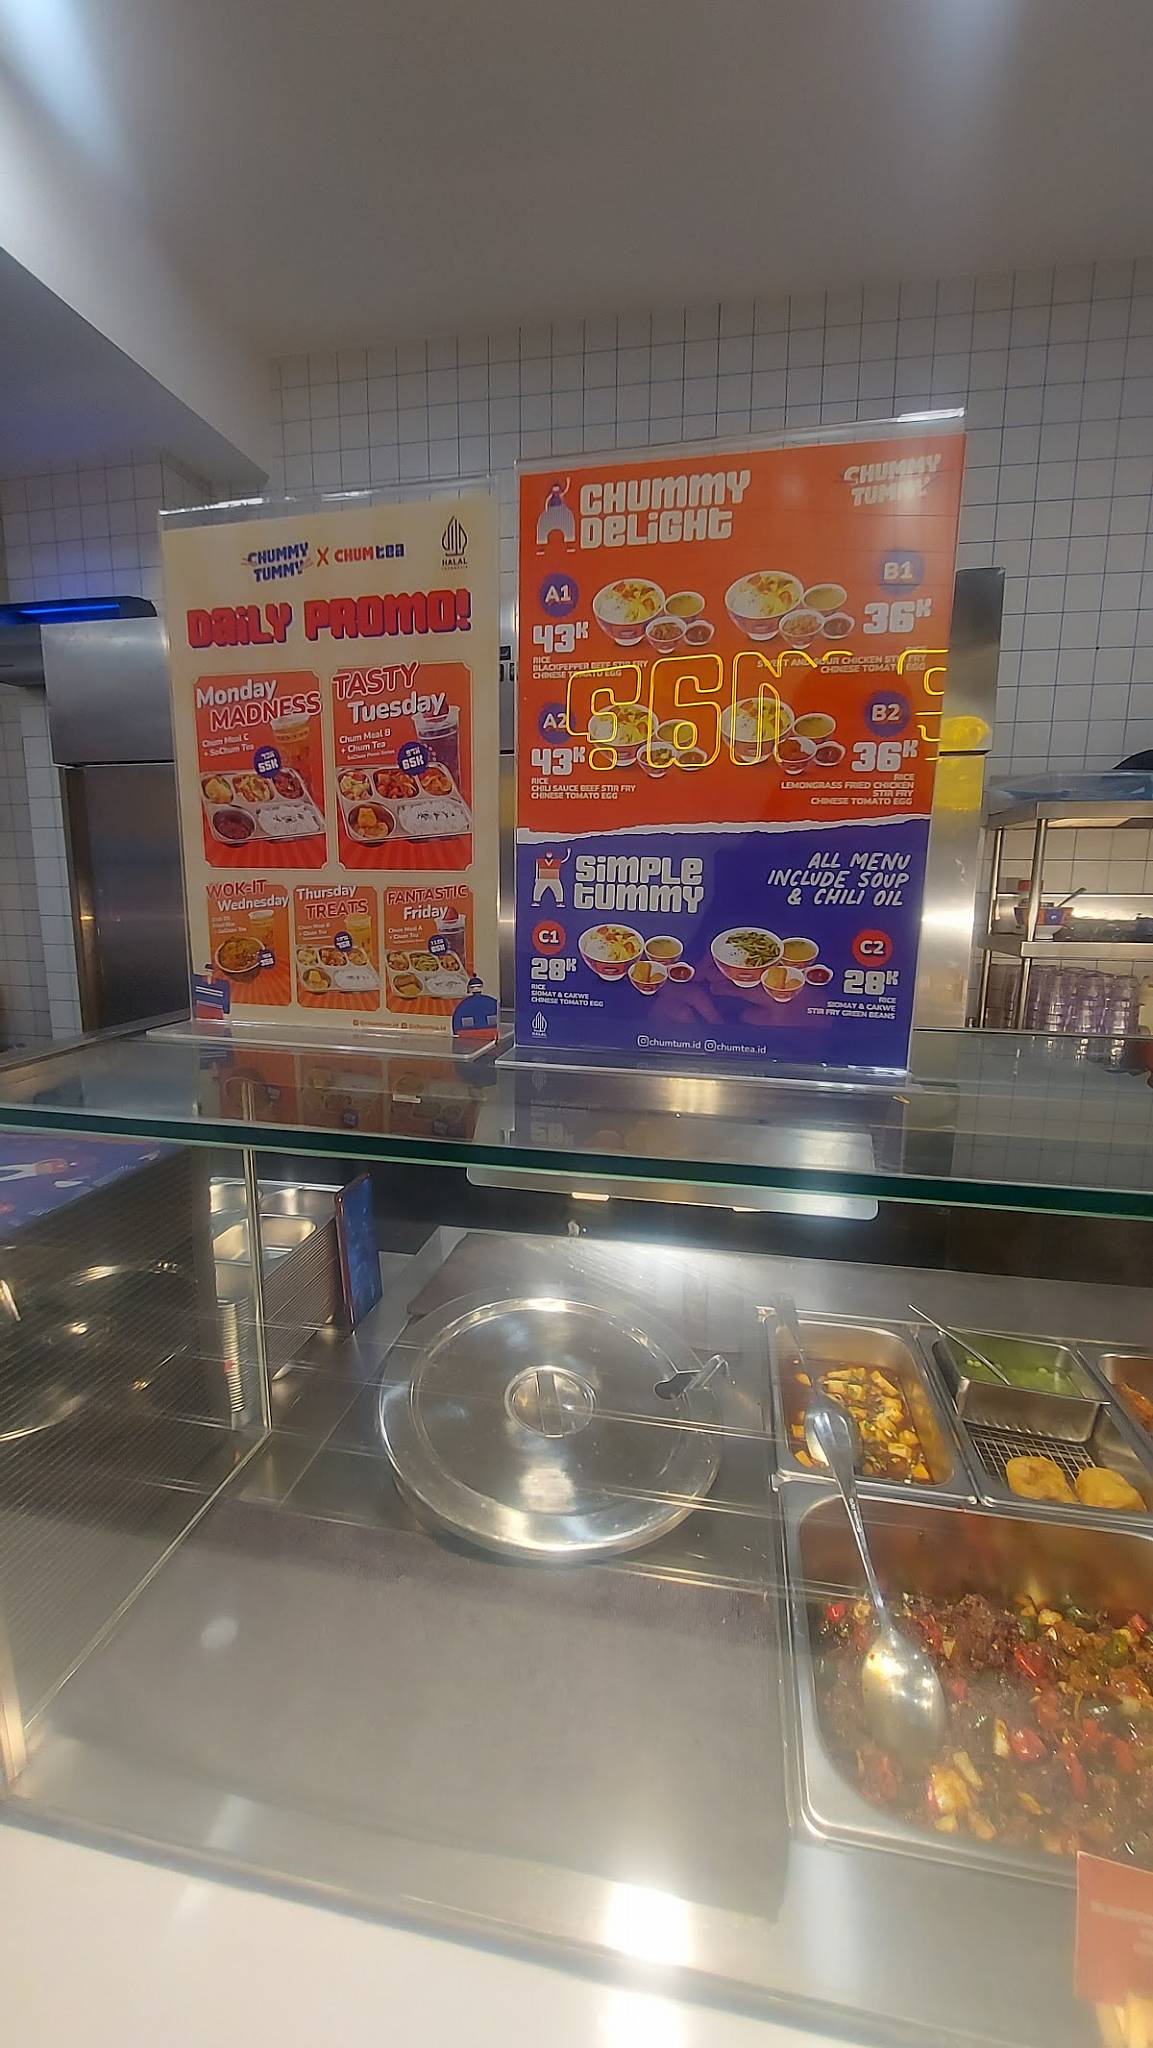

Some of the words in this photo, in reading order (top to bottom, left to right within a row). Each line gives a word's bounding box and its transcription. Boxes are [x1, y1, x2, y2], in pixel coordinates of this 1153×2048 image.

[844, 453, 941, 484] CHUMMY
[580, 470, 750, 516] CHUMMY
[247, 542, 309, 566] CHUMMY
[442, 557, 467, 566] HALAL
[254, 560, 304, 582] TUMMY
[884, 561, 912, 580] B1
[545, 584, 571, 603] A1
[863, 598, 932, 634] 36K
[533, 621, 588, 654] 43K
[533, 656, 551, 664] RICE
[533, 662, 589, 672] BLACKPEPPER
[842, 655, 882, 665] CHICKEN
[908, 654, 927, 662] FRY
[533, 671, 566, 680] CHINESE
[605, 669, 622, 677] EGG
[821, 664, 860, 674] CHINESE
[906, 662, 926, 671] EGG
[332, 660, 420, 700] TASTY
[197, 679, 276, 708] Monday
[210, 691, 321, 732] MADNESS
[347, 691, 445, 723] Tuesday
[872, 704, 900, 722] B2
[543, 713, 567, 729] A2
[340, 735, 361, 744] Chum
[364, 729, 382, 740] Meal
[348, 743, 370, 753] Chum
[372, 741, 386, 749] Tea
[402, 754, 425, 770] 65K
[531, 747, 585, 776] 43K
[851, 740, 918, 772] 36K
[258, 758, 279, 772] 55K
[894, 773, 915, 781] RICE
[531, 784, 551, 792] CHILI
[552, 784, 579, 792] SAUCE
[781, 781, 843, 790] LEMONGRASS
[844, 781, 871, 789] FRIED
[873, 781, 914, 789] CHICKEN
[873, 789, 894, 797] STIR
[895, 789, 914, 797] FRY
[531, 792, 564, 800] CHINESE
[566, 792, 600, 800] TOMATO
[601, 792, 618, 800] EGG
[810, 797, 849, 805] CHINESE
[851, 797, 892, 805] TOMATO
[893, 797, 913, 805] EGG
[808, 852, 841, 869] ALL
[850, 852, 912, 871] MENU
[767, 868, 850, 889] INCLUDE
[857, 871, 911, 889] SOUP
[206, 879, 267, 899] WOK-IT
[296, 885, 357, 900] Thursday
[386, 884, 470, 905] FANTASTIC
[217, 895, 290, 912] Wednesday
[787, 888, 802, 906] &
[813, 888, 864, 906] CHILI
[873, 890, 903, 907] OIL
[304, 899, 369, 920] TREATS
[403, 904, 449, 920] Friday
[538, 930, 559, 944] C1
[860, 940, 885, 955] C2
[531, 957, 577, 981] 28K
[843, 969, 899, 995] 28K
[531, 996, 559, 1004] CHINESE
[560, 998, 588, 1006] TOMATO
[564, 992, 589, 1000] CAKWE
[879, 996, 897, 1004] RICE
[807, 1007, 825, 1015] STIR
[825, 1008, 841, 1016] FRY
[841, 1009, 867, 1018] GREEN
[868, 1011, 896, 1020] BEANS
[827, 1001, 857, 1009] SIOMAY
[866, 1003, 896, 1012] CAKWE
[649, 1039, 701, 1049] chumtum.id
[716, 1042, 767, 1054] chumtea.id
